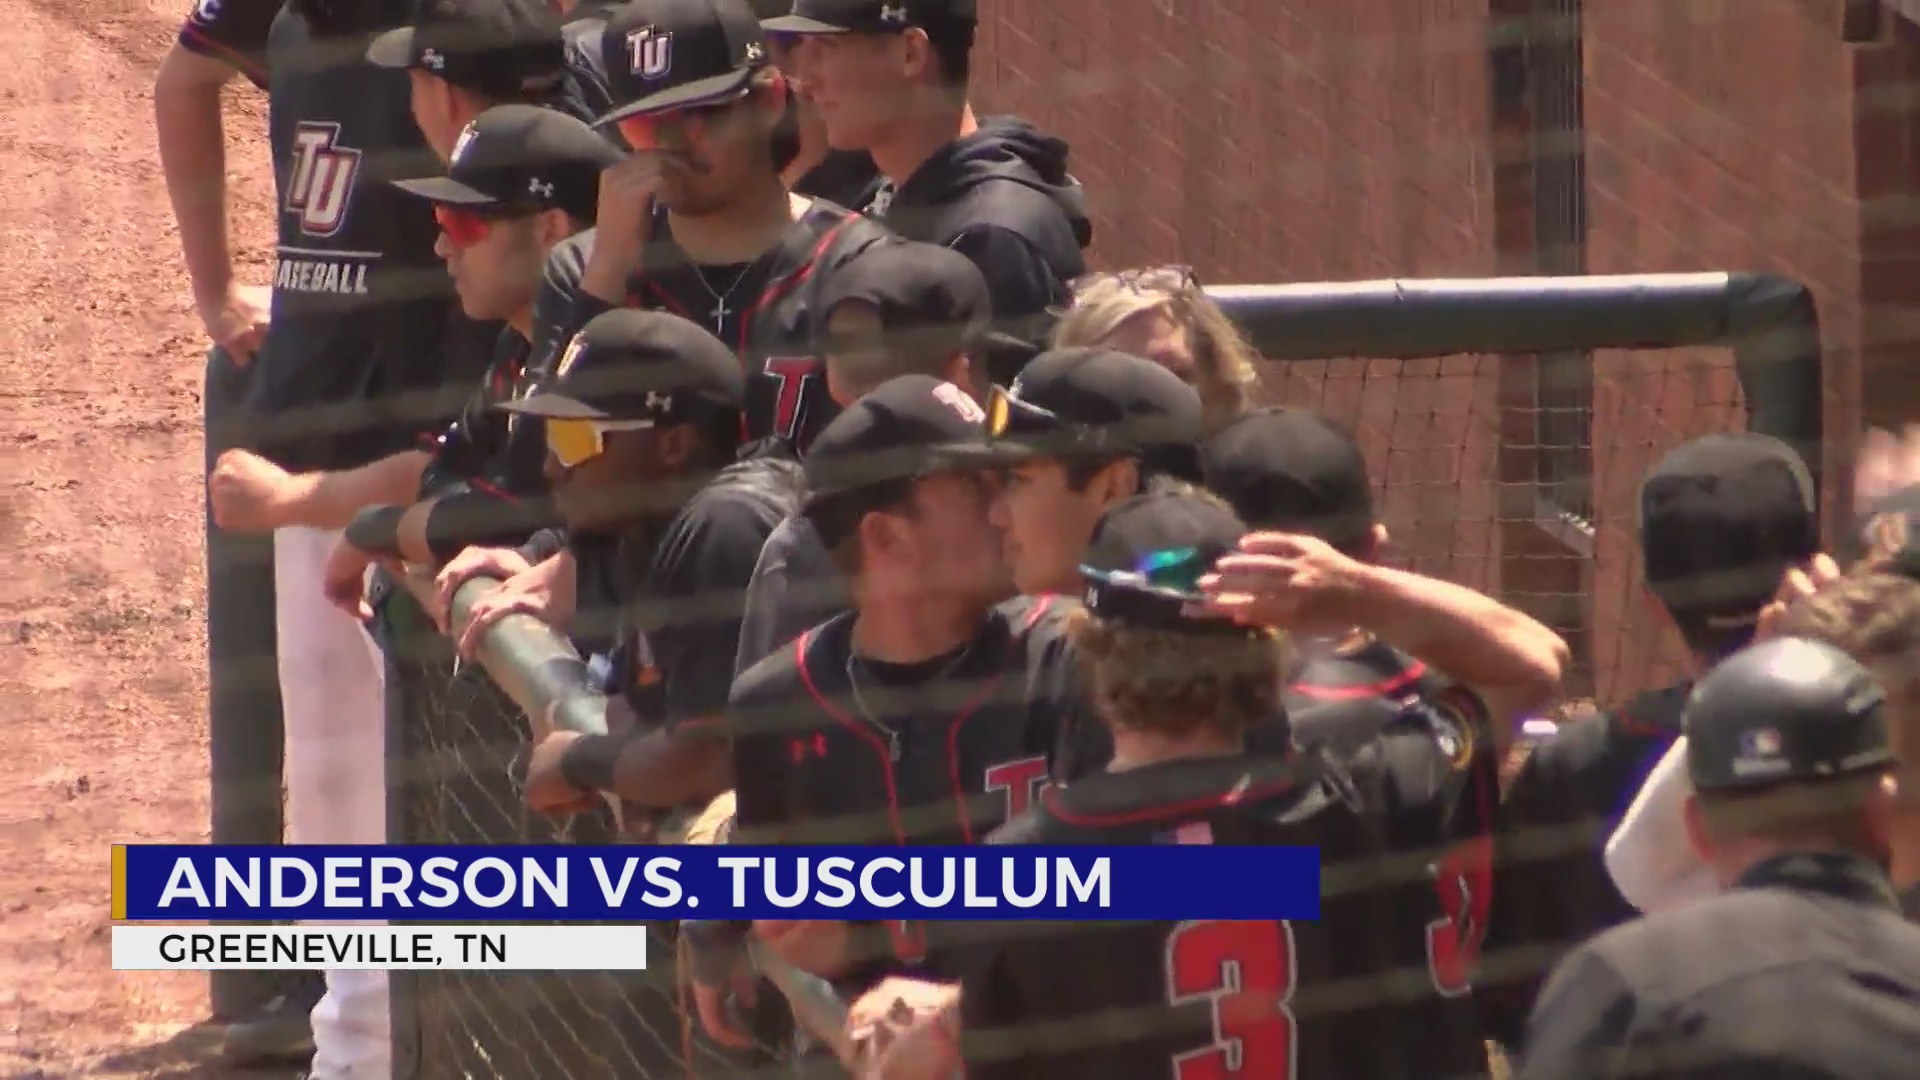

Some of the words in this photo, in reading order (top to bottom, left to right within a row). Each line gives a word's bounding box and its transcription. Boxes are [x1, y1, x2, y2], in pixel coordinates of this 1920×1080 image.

[626, 24, 673, 79] TU
[284, 120, 362, 238] TU
[275, 259, 368, 294] ASEBALL
[1165, 920, 1298, 1080] 3
